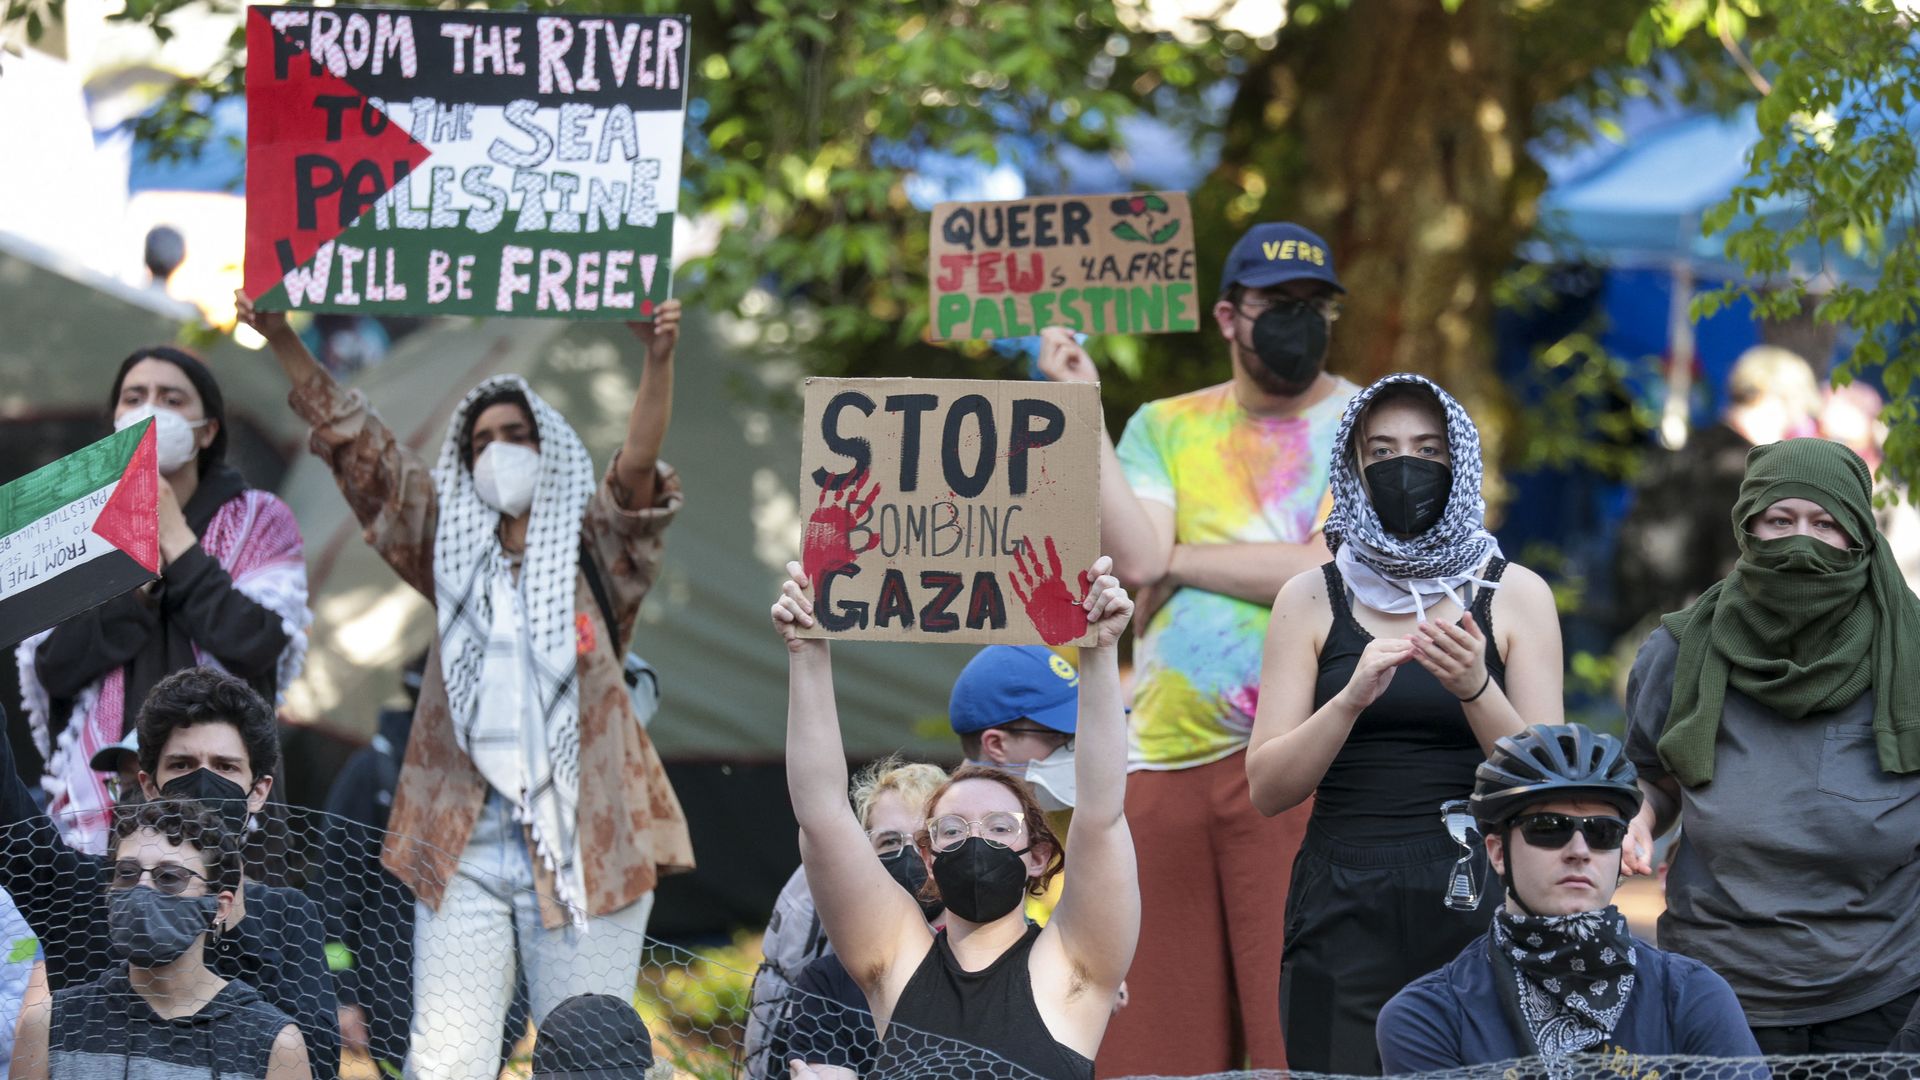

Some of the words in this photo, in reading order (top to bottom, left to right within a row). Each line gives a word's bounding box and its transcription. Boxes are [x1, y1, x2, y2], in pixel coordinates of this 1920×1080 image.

[270, 11, 418, 80] FROM
[440, 22, 527, 76] THE
[536, 17, 684, 94] RIVER
[313, 95, 391, 142] TO
[409, 97, 477, 145] THE
[488, 99, 639, 169] SEA
[294, 154, 660, 234] PALESTINE
[942, 201, 1093, 251] QUEER
[274, 239, 408, 308] WILL
[427, 249, 477, 304] BE
[495, 244, 659, 317] FREE!
[1262, 240, 1326, 267] VERS
[937, 283, 1197, 339] PALESTINE
[811, 389, 1067, 499] STOP
[44, 538, 88, 573] FROM
[845, 499, 1026, 558] BOMBING
[8, 561, 39, 589] THE
[814, 562, 1008, 634] GAZA
